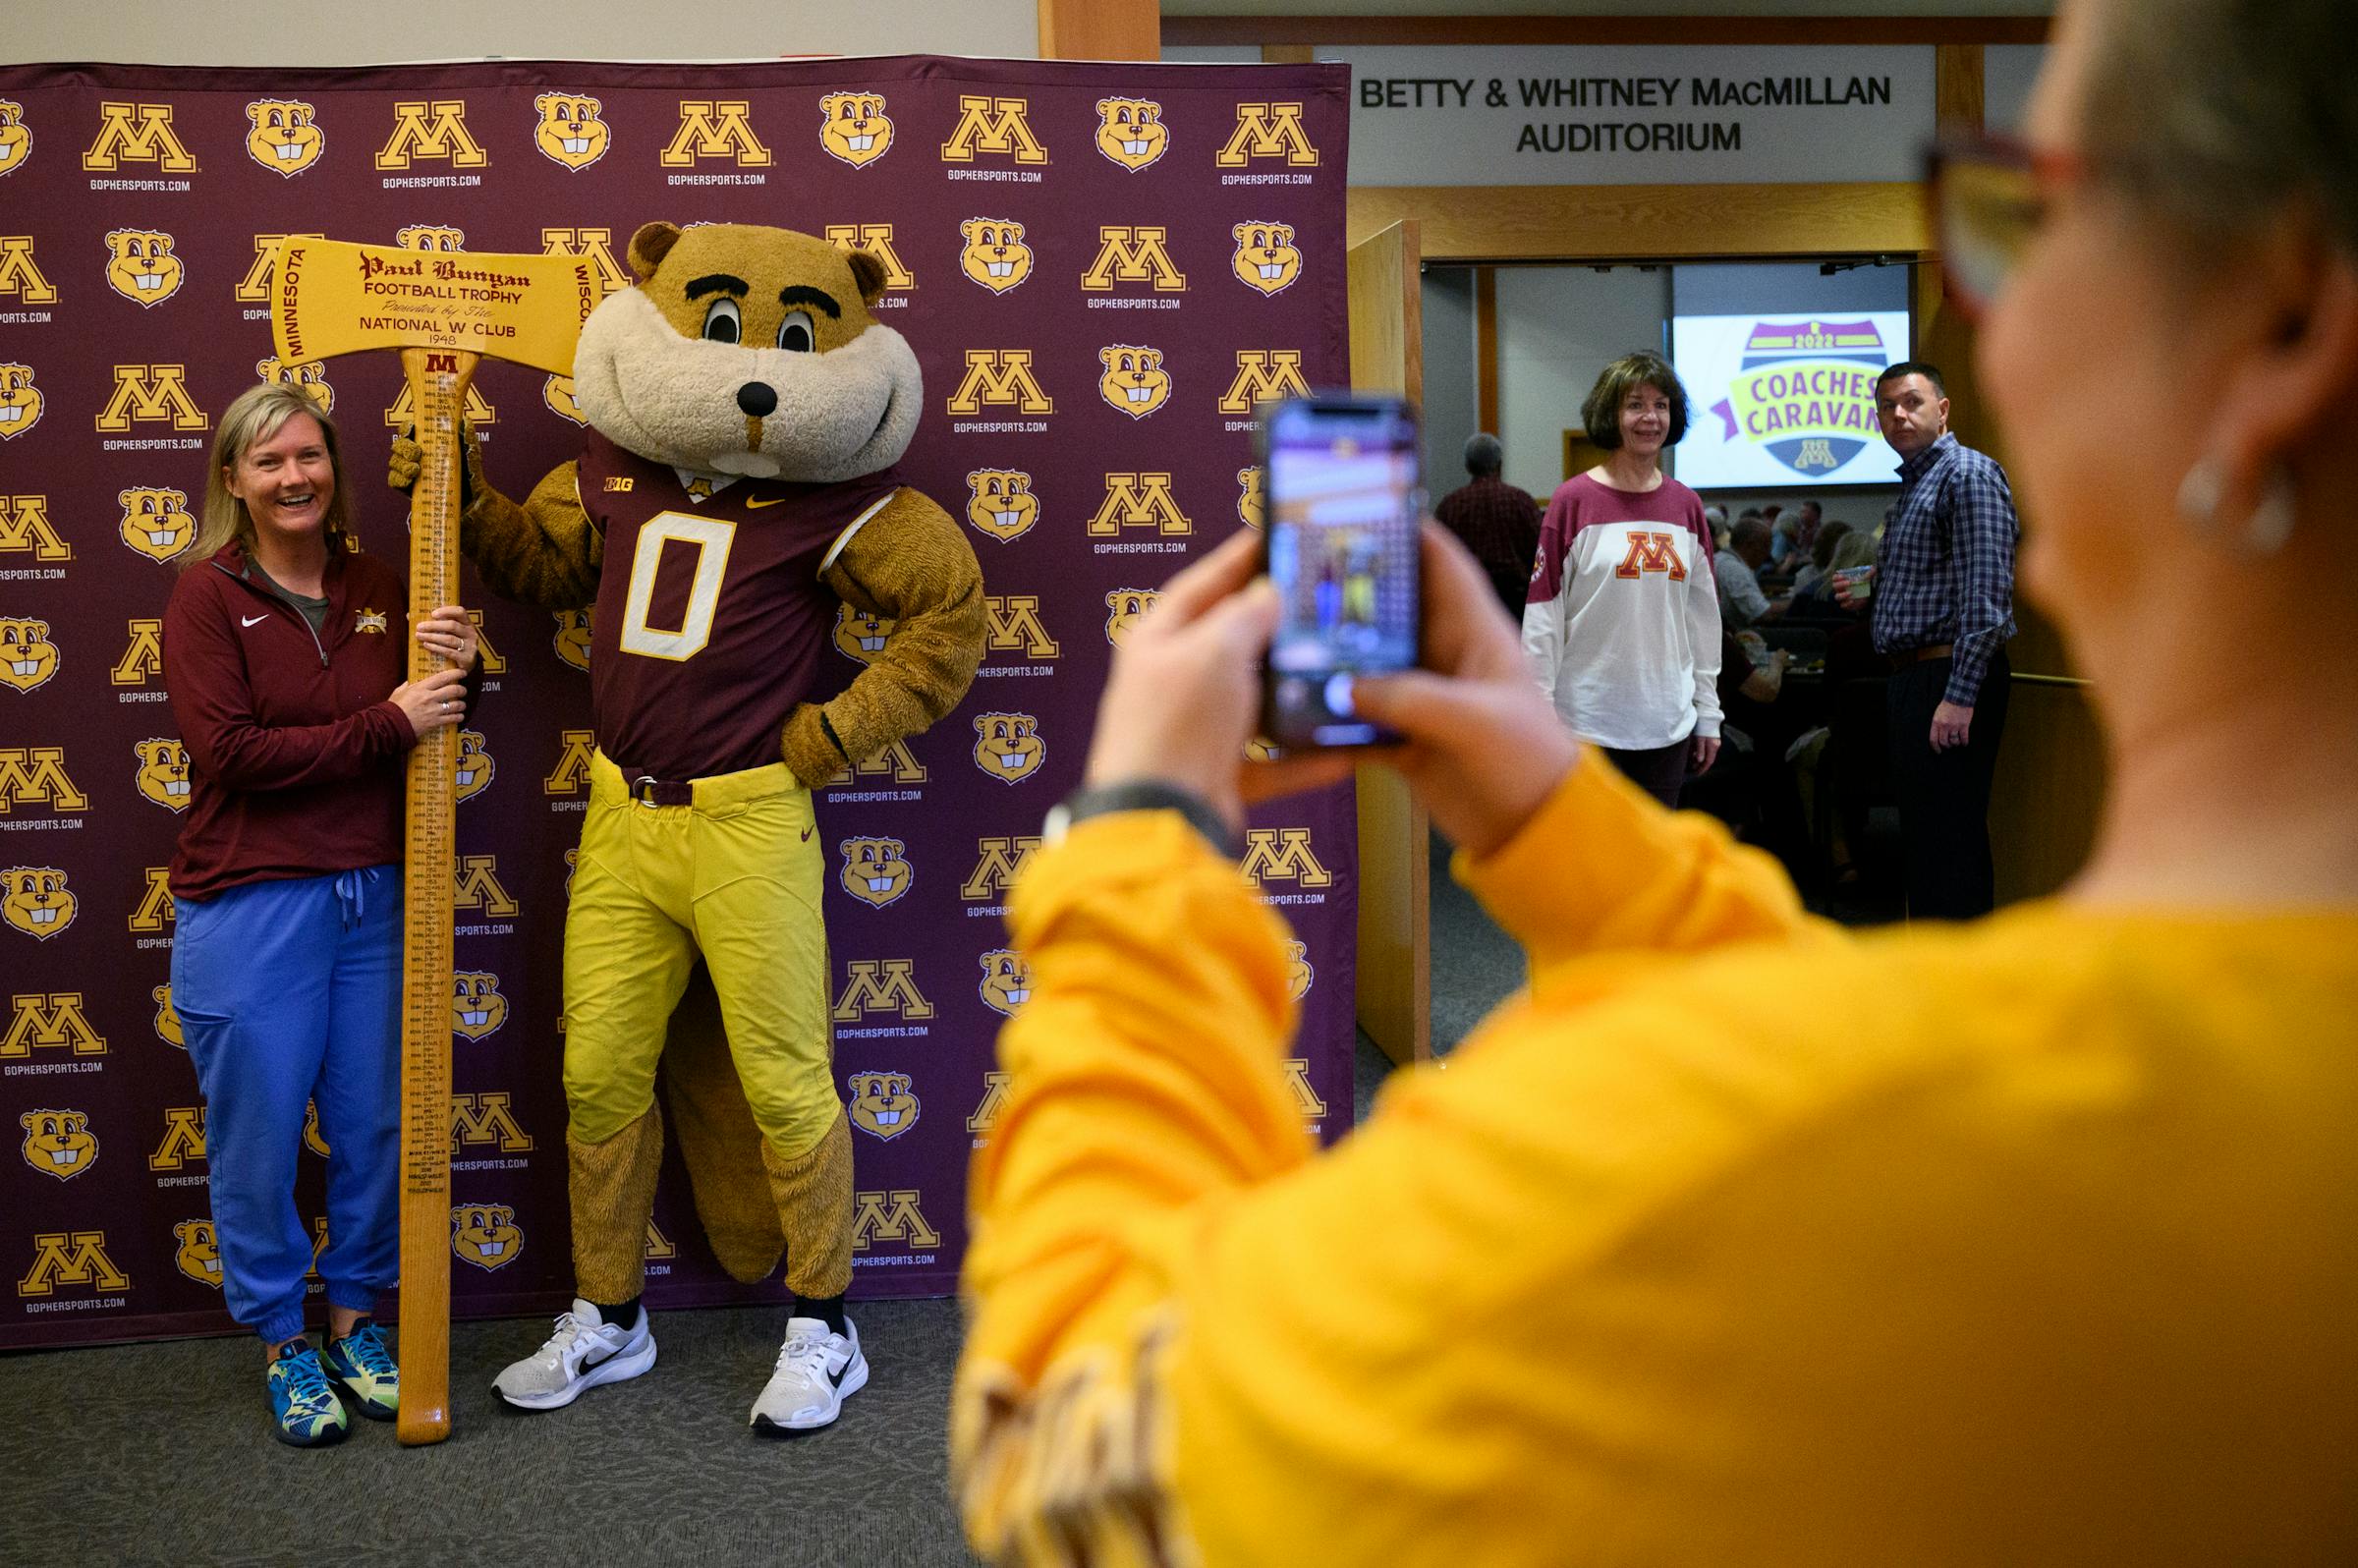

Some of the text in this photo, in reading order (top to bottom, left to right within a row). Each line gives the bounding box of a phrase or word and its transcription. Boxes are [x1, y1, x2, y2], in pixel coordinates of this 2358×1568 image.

[1360, 78, 1476, 108] BETTY
[1485, 78, 1510, 108] &
[1518, 77, 1681, 107] WHITNEY
[1516, 123, 1741, 152] AUDITORIUM
[382, 175, 481, 190] GOPHERSPORTS.COM
[668, 174, 765, 186] GOPHERSPORTS.COM
[948, 169, 1042, 184] GOPHERSPORTS.COM
[1221, 175, 1313, 186] GOPHERSPORTS.COM
[90, 179, 192, 193] GOPHERSPORTS.COM
[359, 250, 423, 281] Paul
[432, 259, 532, 288] Bunyan
[365, 282, 523, 305] FOOTBALL TROPHY
[574, 264, 592, 325] WISCO
[283, 249, 307, 358] MINNESOTA
[382, 300, 495, 319] Presented by The
[1088, 298, 1181, 309] GOPHERSPORTS.COM
[0, 312, 51, 324] ORTS.COM
[360, 316, 516, 338] NATIONAL W CLUB
[429, 334, 457, 346] 1948
[424, 354, 459, 373] M
[954, 421, 1047, 432] GOPHERSPORTS.COM
[103, 438, 203, 451] GOPHERSPORTS.COM
[1095, 542, 1187, 554] GOPHERSPORTS.COM
[1616, 532, 1687, 582] M
[0, 568, 66, 581] RSPORTS.COM
[619, 510, 738, 662] 0
[975, 666, 1055, 678] HERSPORTS.COM
[119, 692, 169, 703] GOPHERSP
[828, 790, 923, 804] GOPHERSPORTS.COM
[0, 818, 84, 831] PHERSPORTS.COM
[967, 906, 1015, 918] GOPHERSP
[455, 924, 514, 936] SPORTS.COM
[836, 1026, 928, 1039] GOPHERSPORTS.COM
[4, 1062, 103, 1076] GOPHERSPORTS.COM
[450, 1158, 529, 1172] HERSPORTS.COM
[851, 1254, 935, 1267] OPHERSPORTS.COM
[27, 1298, 126, 1314] GOPHERSPORTS.COM
